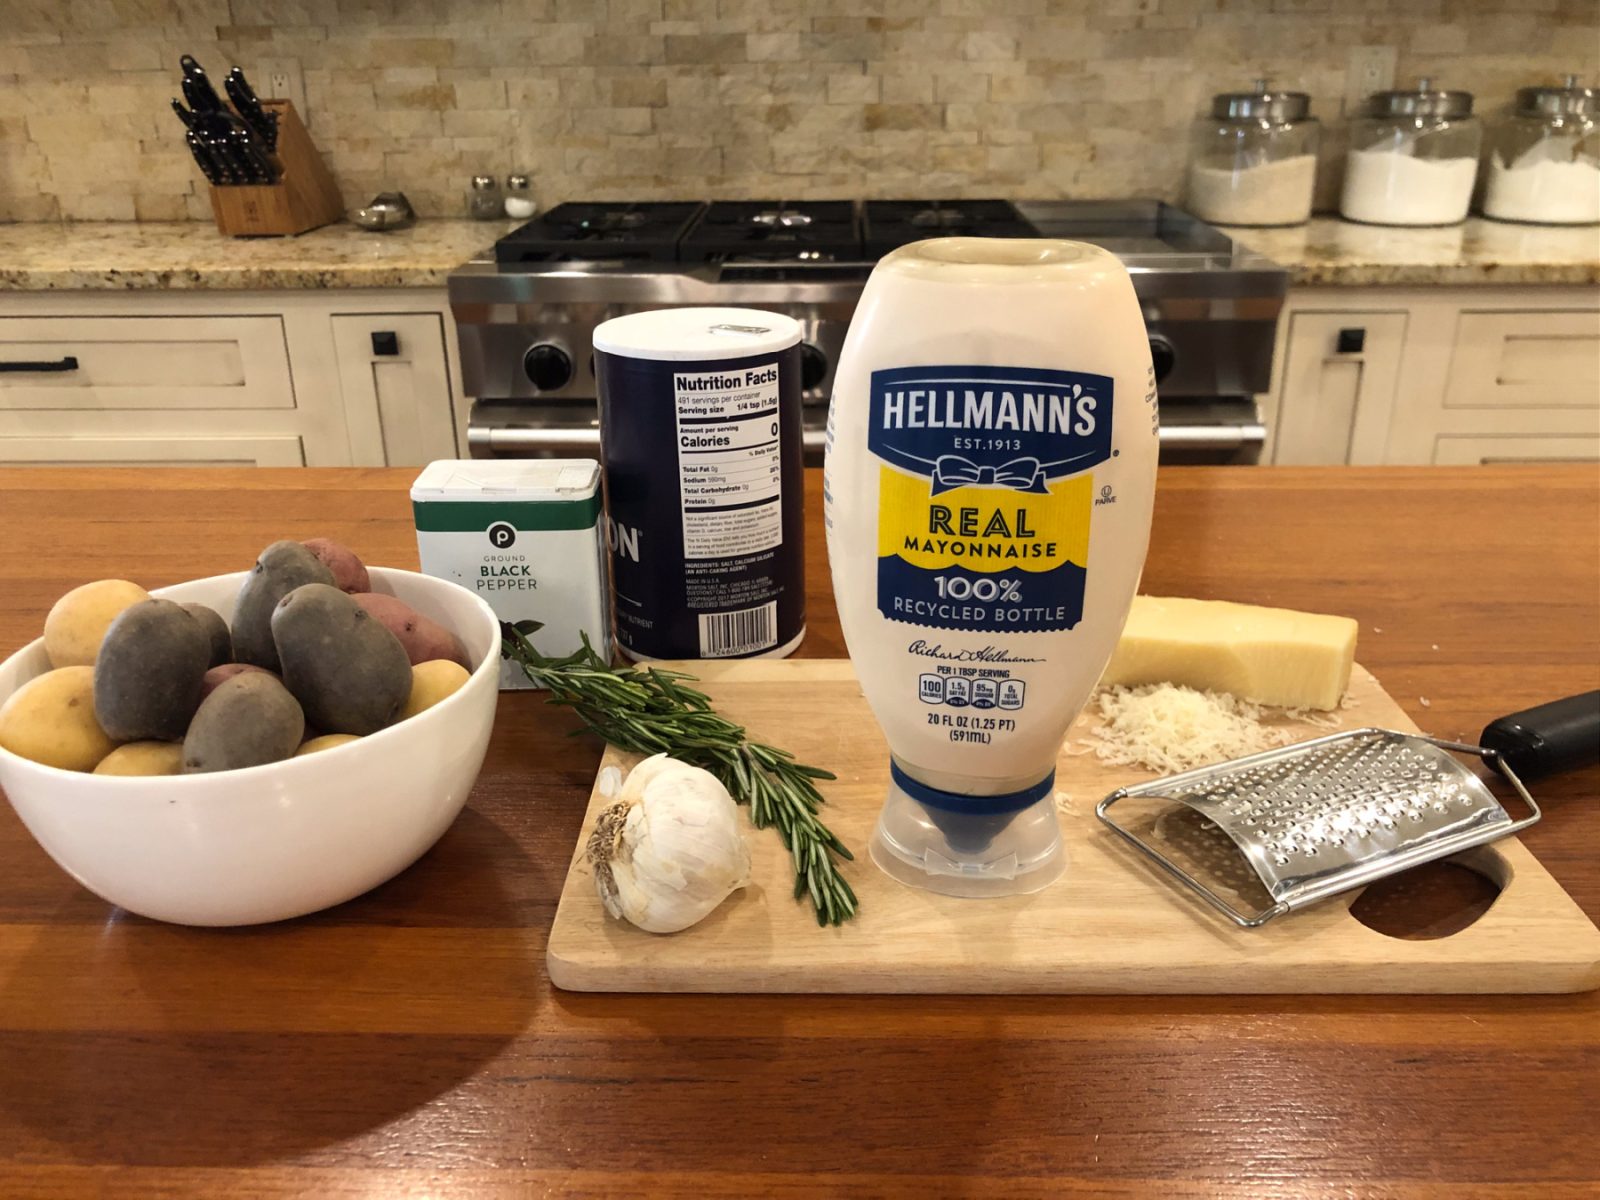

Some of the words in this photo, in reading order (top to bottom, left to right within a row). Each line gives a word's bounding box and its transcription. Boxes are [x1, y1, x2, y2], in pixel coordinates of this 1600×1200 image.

[676, 376, 741, 391] Nutrition
[745, 369, 777, 386] Facts
[678, 396, 690, 404] 491
[692, 395, 719, 405] servings
[721, 394, 732, 403] per
[733, 391, 761, 402] container
[678, 406, 707, 415] Serving
[709, 405, 725, 413] size
[737, 402, 748, 411] 1/4
[750, 401, 760, 410] tsp
[761, 396, 778, 409] (1.5g)
[882, 383, 1097, 437] HELLMANN'S
[680, 426, 704, 434] Amount
[705, 426, 715, 434] per
[717, 424, 739, 433] serving
[771, 422, 778, 436] 0
[681, 436, 730, 447] Calories
[953, 437, 1021, 451] EST.1913
[711, 465, 718, 473] 0g
[683, 476, 706, 484] Sodium
[700, 484, 741, 495] Carbohydrate
[929, 504, 1036, 538] REAL
[904, 535, 1057, 558] MAYONNAISE
[483, 555, 526, 563] GROUND
[480, 565, 531, 577] BLACK
[477, 579, 537, 591] PEPPER
[934, 575, 1023, 602] 100%
[894, 596, 985, 621] RECYCLED
[994, 606, 1065, 622] BOTTLE
[937, 665, 951, 675] PER
[958, 667, 978, 677] TBSP
[978, 669, 1010, 679] SERVING
[922, 680, 941, 693] 100
[921, 691, 942, 699] CALORIES
[927, 713, 940, 725] 20
[942, 714, 954, 727] FL
[956, 716, 968, 728] OZ
[971, 717, 995, 730] (1.25
[999, 719, 1016, 732] PT)
